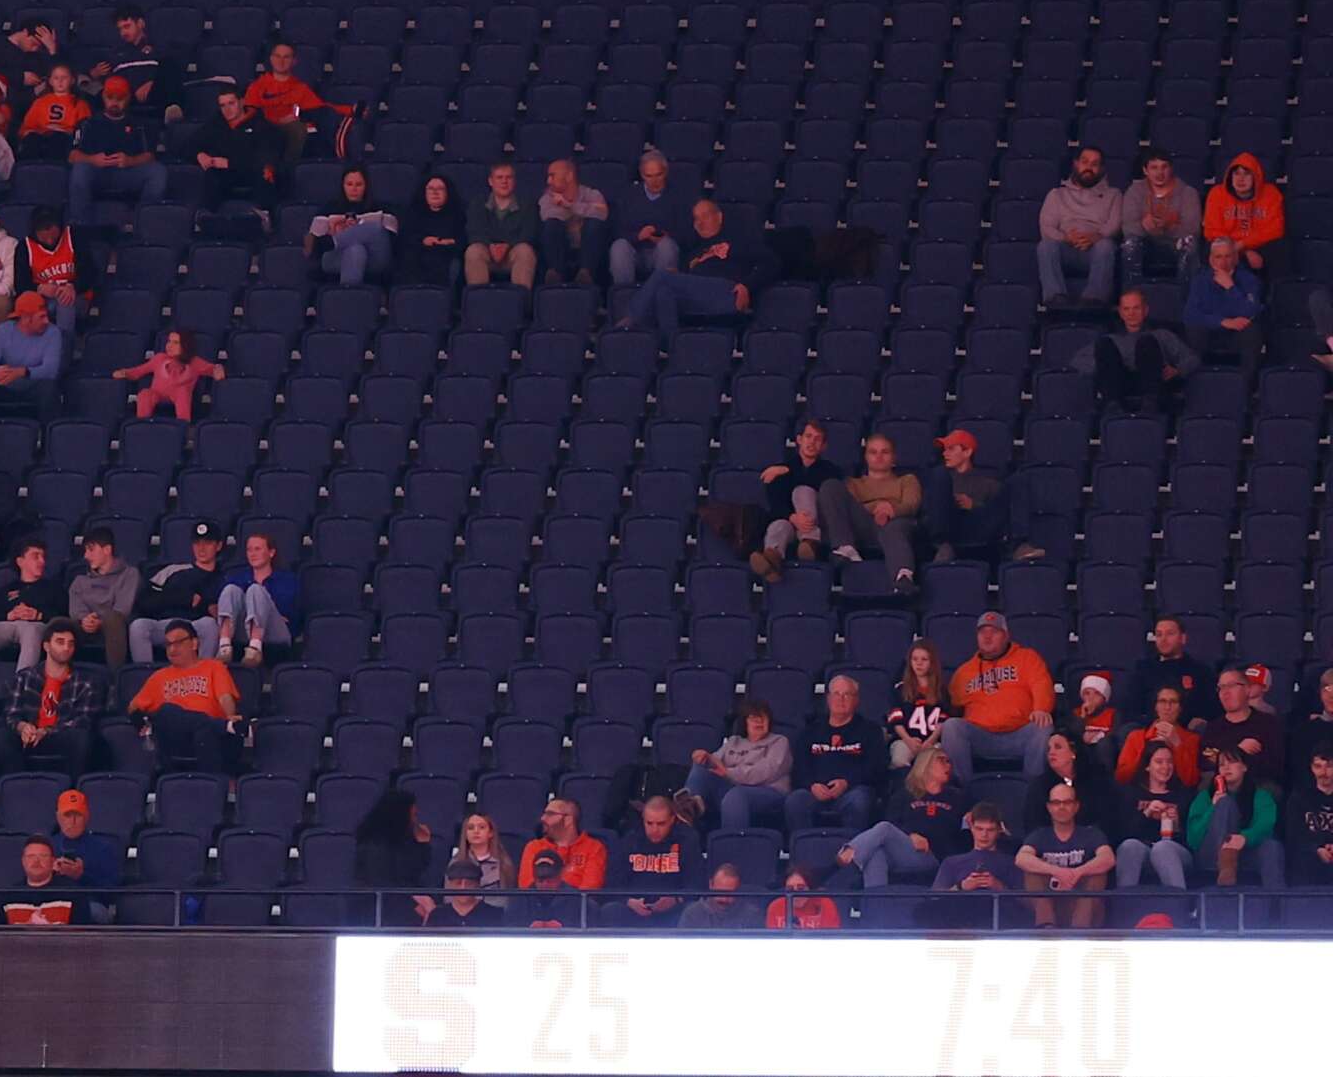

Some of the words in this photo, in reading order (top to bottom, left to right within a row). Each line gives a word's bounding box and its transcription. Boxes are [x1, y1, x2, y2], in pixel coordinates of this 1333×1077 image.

[50, 105, 63, 120] S
[909, 705, 944, 736] 44
[532, 953, 629, 1061] 25
[927, 947, 1131, 1075] 7:40
